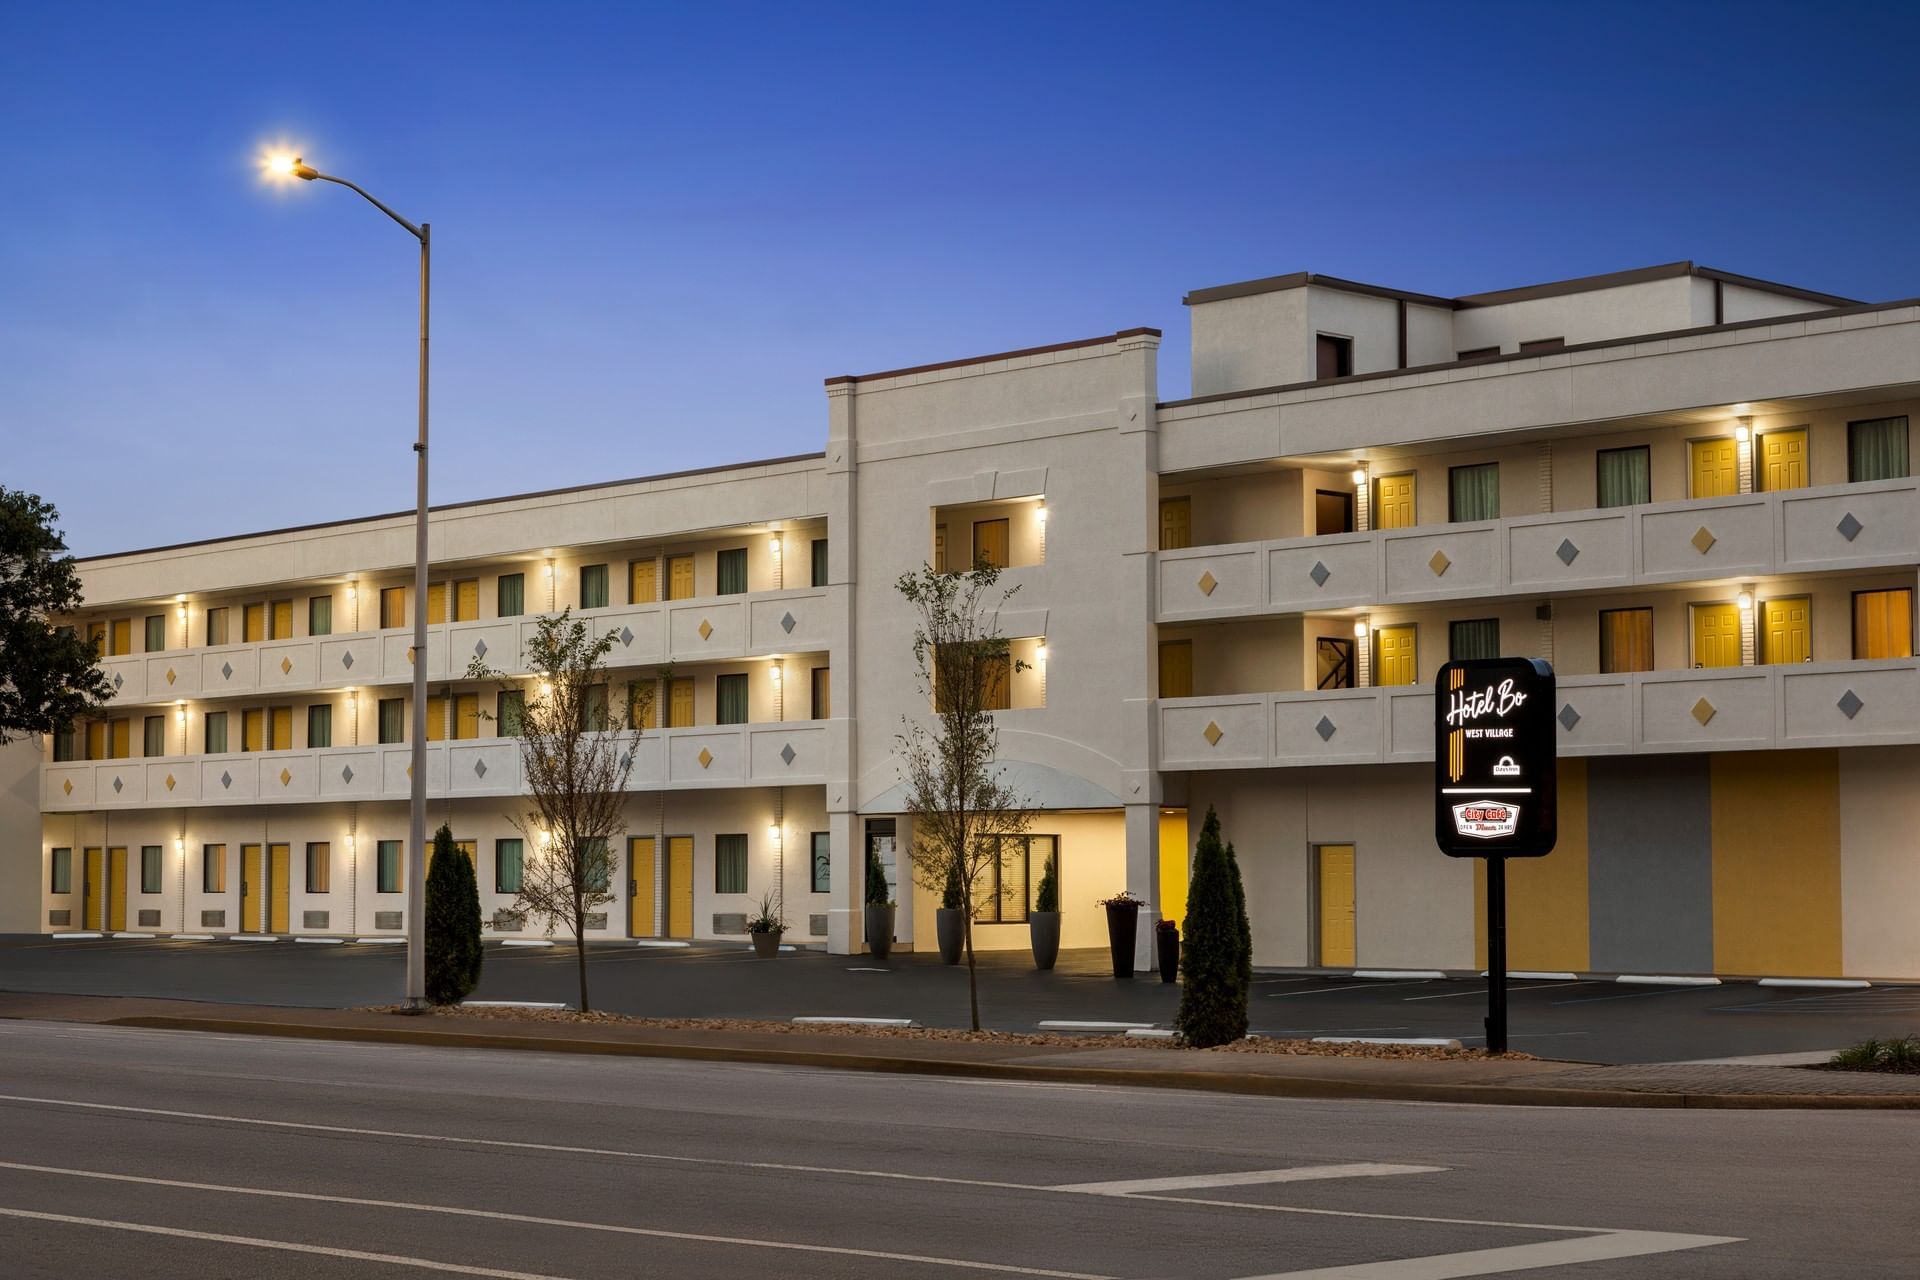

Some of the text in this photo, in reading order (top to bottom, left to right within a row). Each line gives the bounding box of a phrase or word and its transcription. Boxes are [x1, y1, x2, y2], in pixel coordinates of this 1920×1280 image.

[1446, 678, 1528, 726] Hotel Bo
[1465, 728, 1514, 738] WEST VILLAGE
[1465, 808, 1484, 822] City
